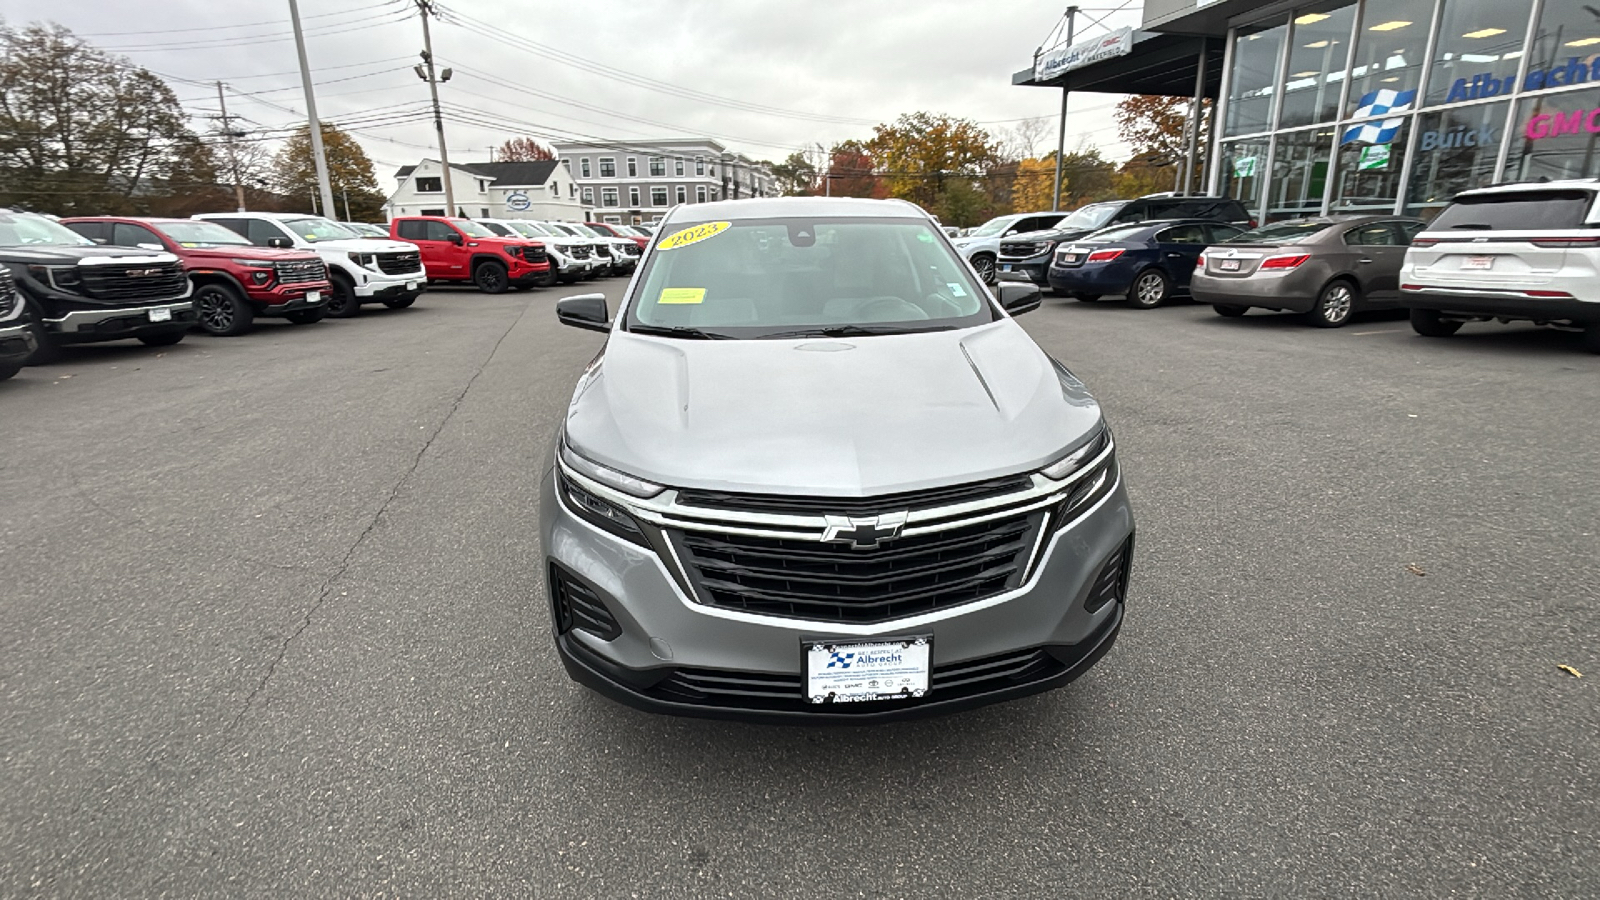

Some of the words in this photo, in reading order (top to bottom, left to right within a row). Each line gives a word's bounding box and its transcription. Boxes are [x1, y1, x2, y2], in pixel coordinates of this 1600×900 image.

[1045, 52, 1080, 70] Albrecht
[1525, 108, 1600, 140] GMC
[1421, 124, 1497, 151] Buick
[671, 223, 719, 247] 2023
[856, 653, 902, 664] Albrecht
[833, 693, 877, 704] Albrecht
